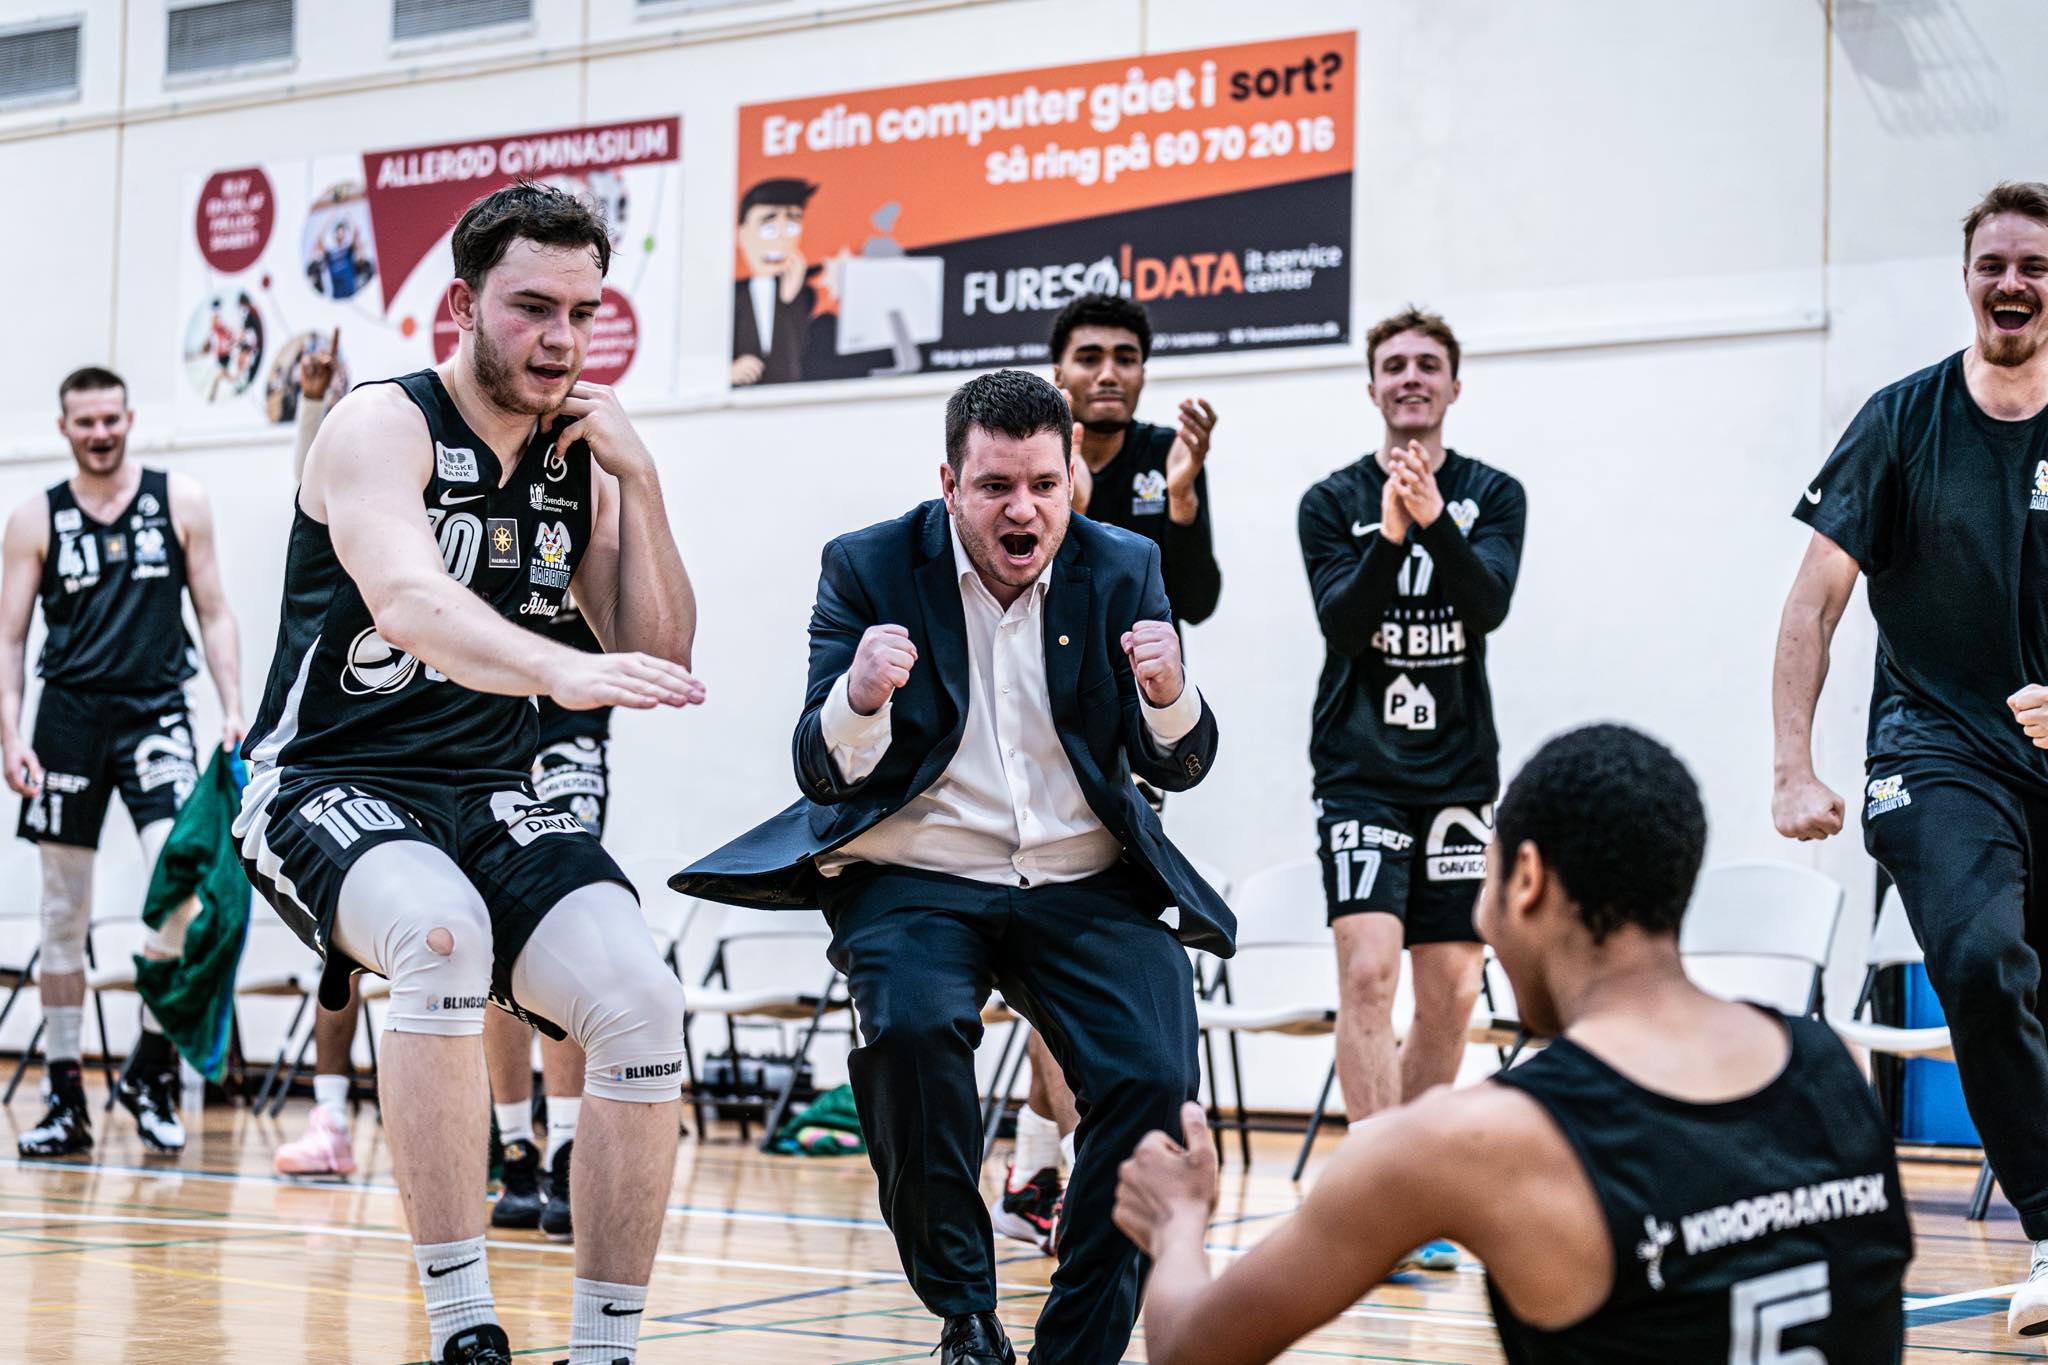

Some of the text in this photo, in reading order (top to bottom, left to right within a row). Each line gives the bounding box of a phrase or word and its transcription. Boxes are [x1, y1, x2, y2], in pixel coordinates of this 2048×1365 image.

[762, 51, 1342, 156] Er din computer gået i sort?
[375, 124, 669, 190] ALLERØD GYMNASIUM
[985, 116, 1335, 186] Så ring på 60 70 20 16
[1244, 270, 1314, 293] center
[543, 494, 578, 511] Svendborg
[58, 533, 100, 577] 41
[1390, 693, 1407, 715] P
[1414, 705, 1428, 724] B
[313, 797, 406, 850] 10
[1334, 850, 1382, 903] 17
[1680, 1173, 1889, 1255] KIROPRAKTISK
